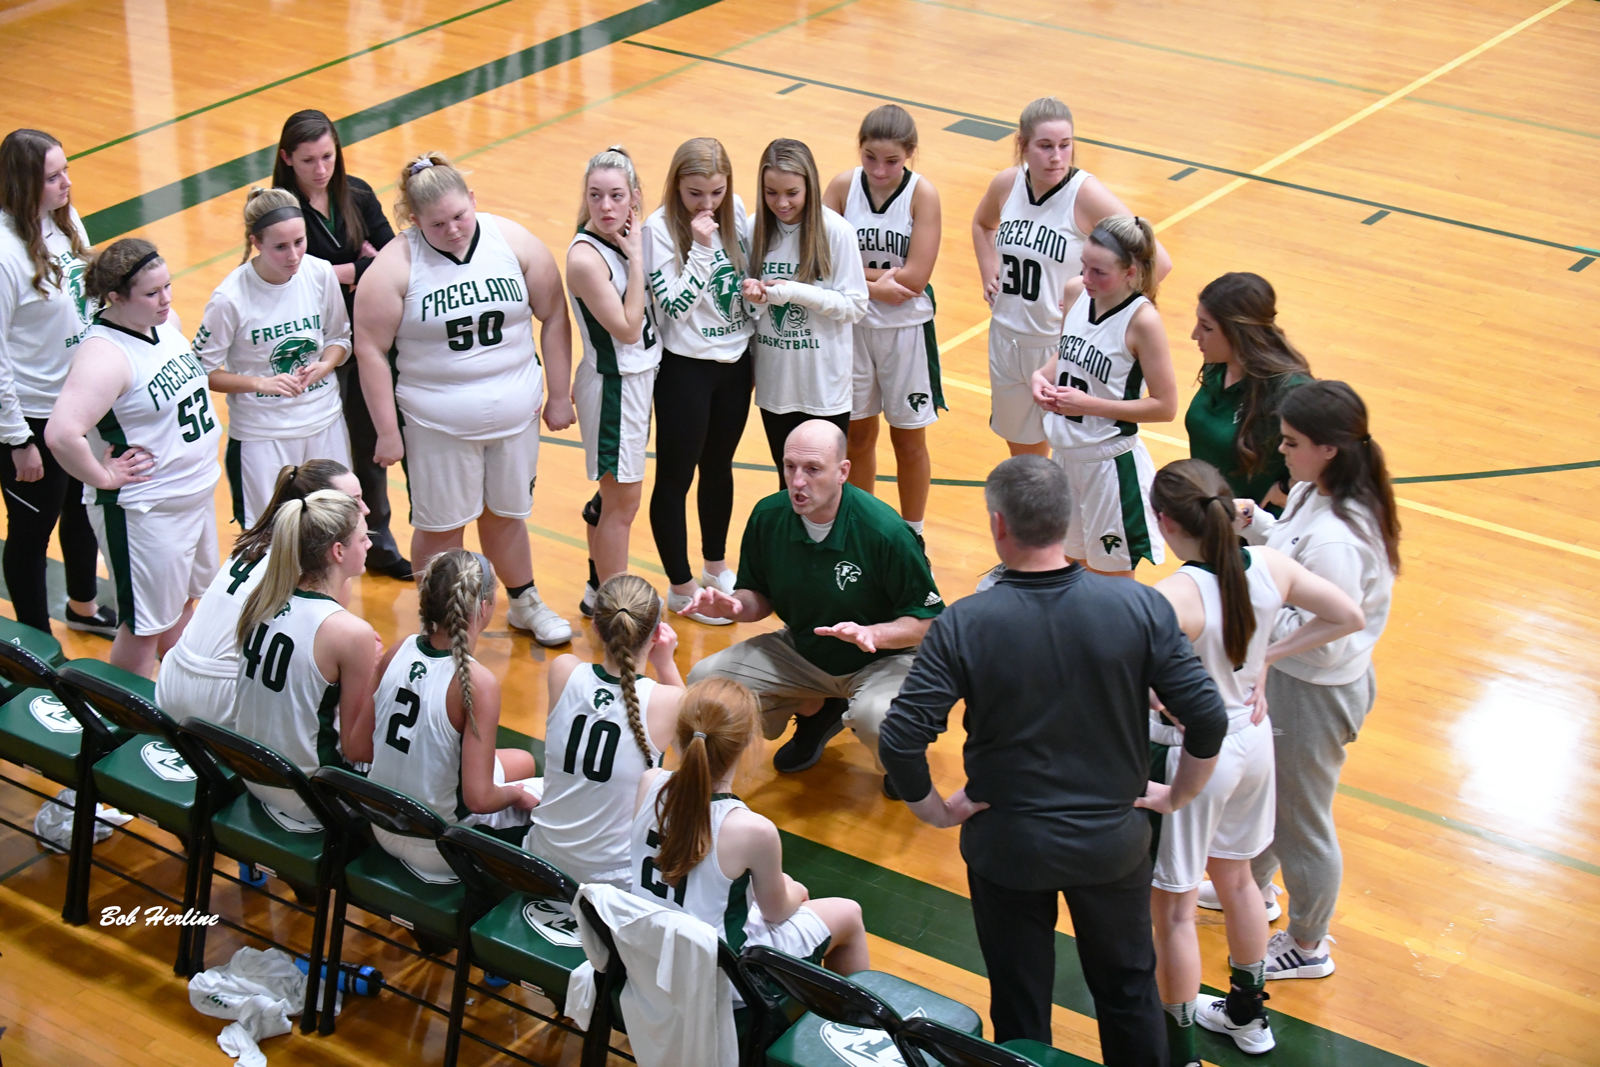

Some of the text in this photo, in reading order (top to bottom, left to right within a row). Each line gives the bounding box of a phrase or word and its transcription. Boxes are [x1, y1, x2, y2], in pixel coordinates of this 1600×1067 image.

[856, 228, 910, 259] EELAND
[761, 262, 800, 276] REEL
[1002, 253, 1042, 302] 30
[421, 277, 523, 322] FREELAND
[445, 310, 505, 351] 50
[701, 315, 750, 338] BASKET
[757, 333, 821, 350] BASKETBALL
[783, 328, 812, 338] GIRLS
[147, 353, 208, 412] FREELAN
[1058, 335, 1113, 385] REELAND
[177, 387, 215, 443] 52
[226, 548, 268, 596] 4
[242, 621, 295, 693] 40
[385, 687, 421, 755] 2
[563, 713, 622, 783] 10
